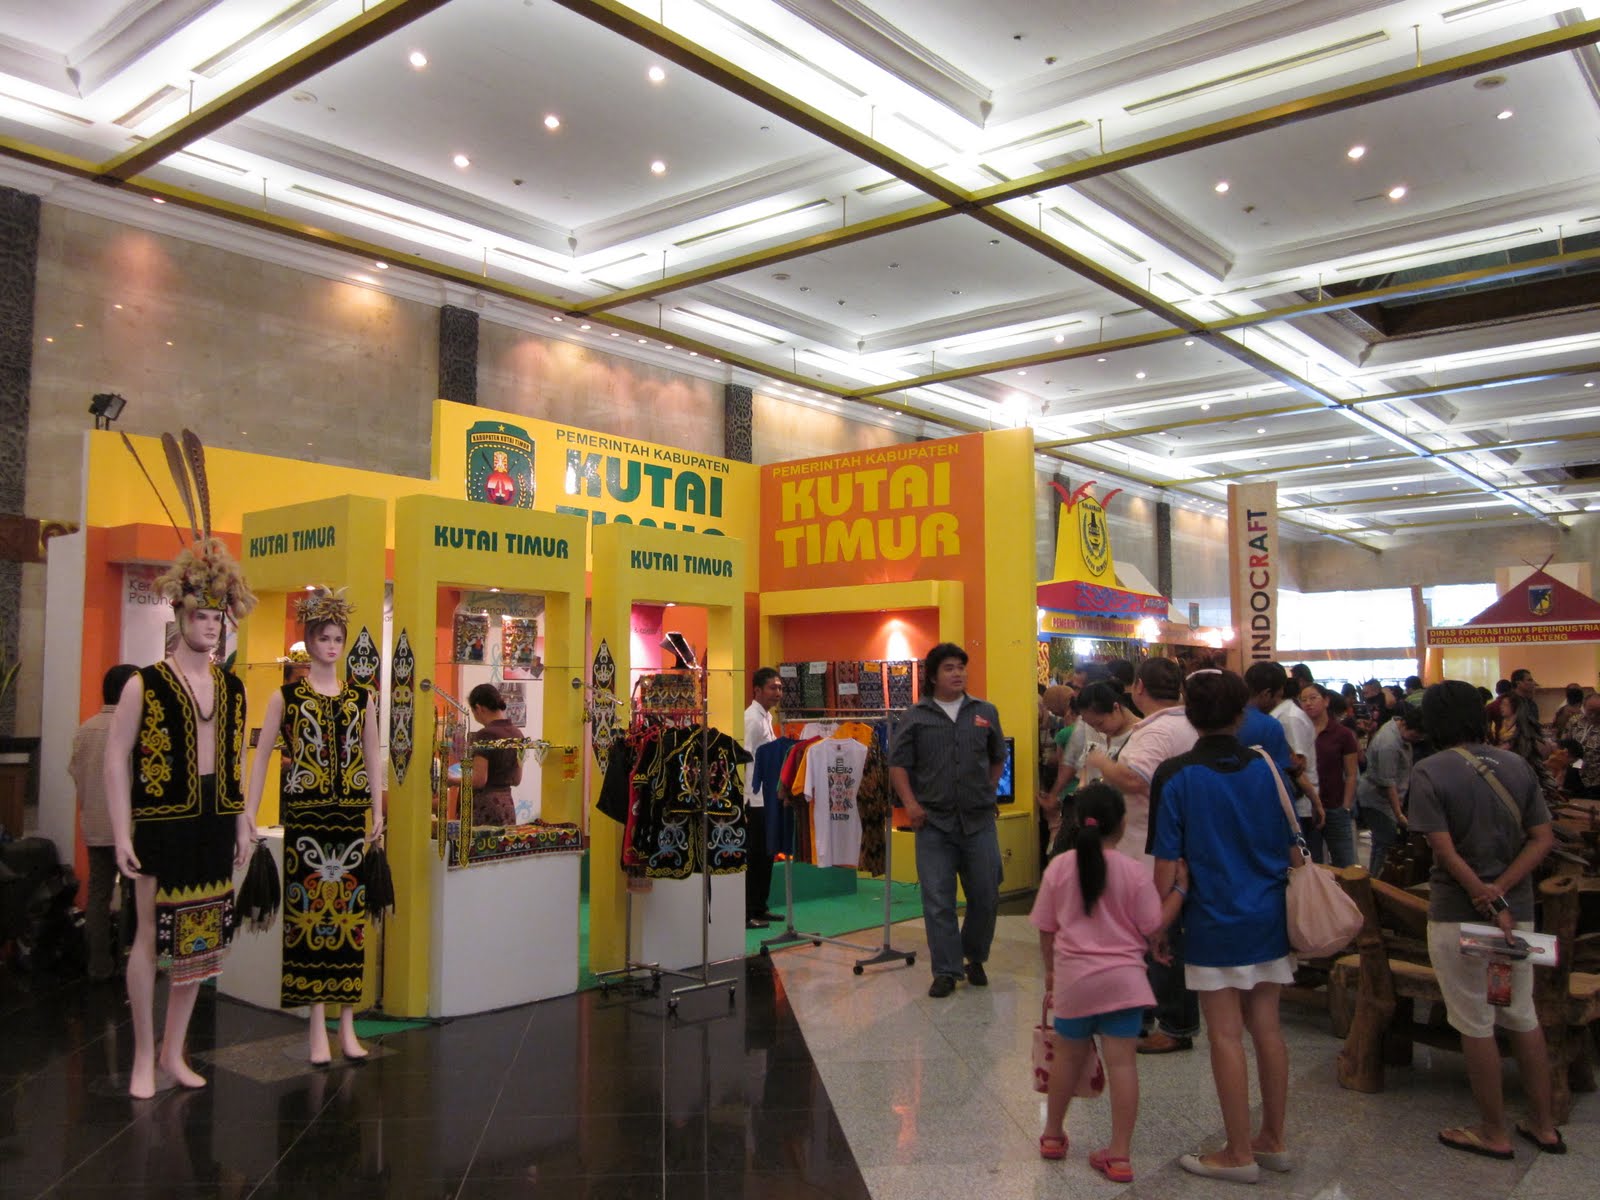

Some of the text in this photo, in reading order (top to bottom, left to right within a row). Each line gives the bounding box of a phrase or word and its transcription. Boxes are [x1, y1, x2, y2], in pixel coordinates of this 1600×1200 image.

[556, 429, 730, 474] PEMERINTAH KABUPATEN
[772, 443, 959, 478] PEMERINTAH KABUPATEN
[565, 448, 723, 518] KUTAI
[781, 461, 951, 522] KUTAI
[250, 525, 335, 558] KUTAI TIMUR
[434, 525, 569, 559] KUTAI TIMUR
[774, 511, 961, 568] TIMUR
[630, 550, 733, 578] KUTAI TIMUR
[1246, 509, 1271, 659] INDOCRAFT
[1430, 624, 1600, 637] DINAS KOPERASI UMKM PERINDUSTRIA
[1430, 636, 1496, 644] PERDAGANGAN
[1526, 633, 1568, 642] SULTENG
